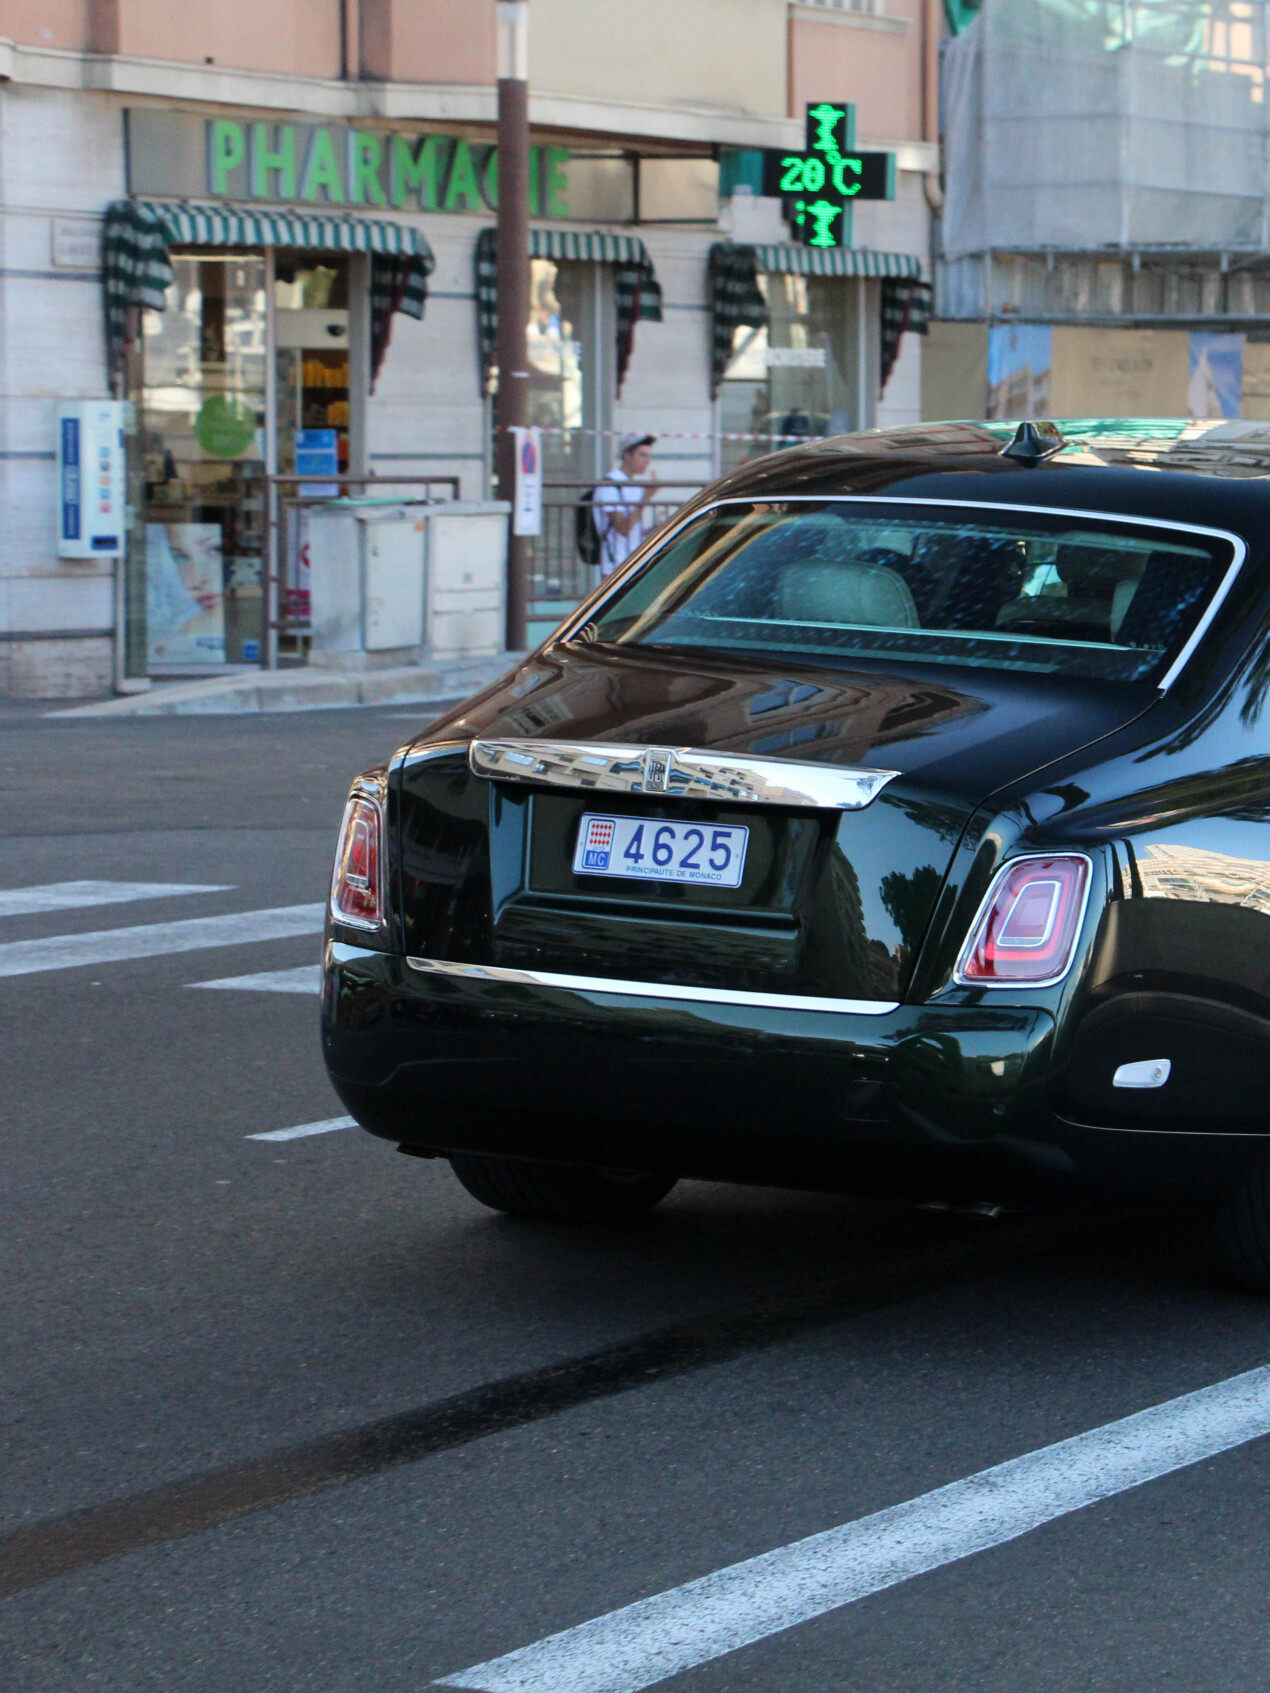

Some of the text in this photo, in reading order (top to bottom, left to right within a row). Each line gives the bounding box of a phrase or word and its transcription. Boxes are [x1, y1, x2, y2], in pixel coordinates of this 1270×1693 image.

[623, 824, 733, 871] 4625
[588, 852, 606, 866] MC
[676, 869, 687, 878] DE
[689, 871, 722, 881] MONACO
